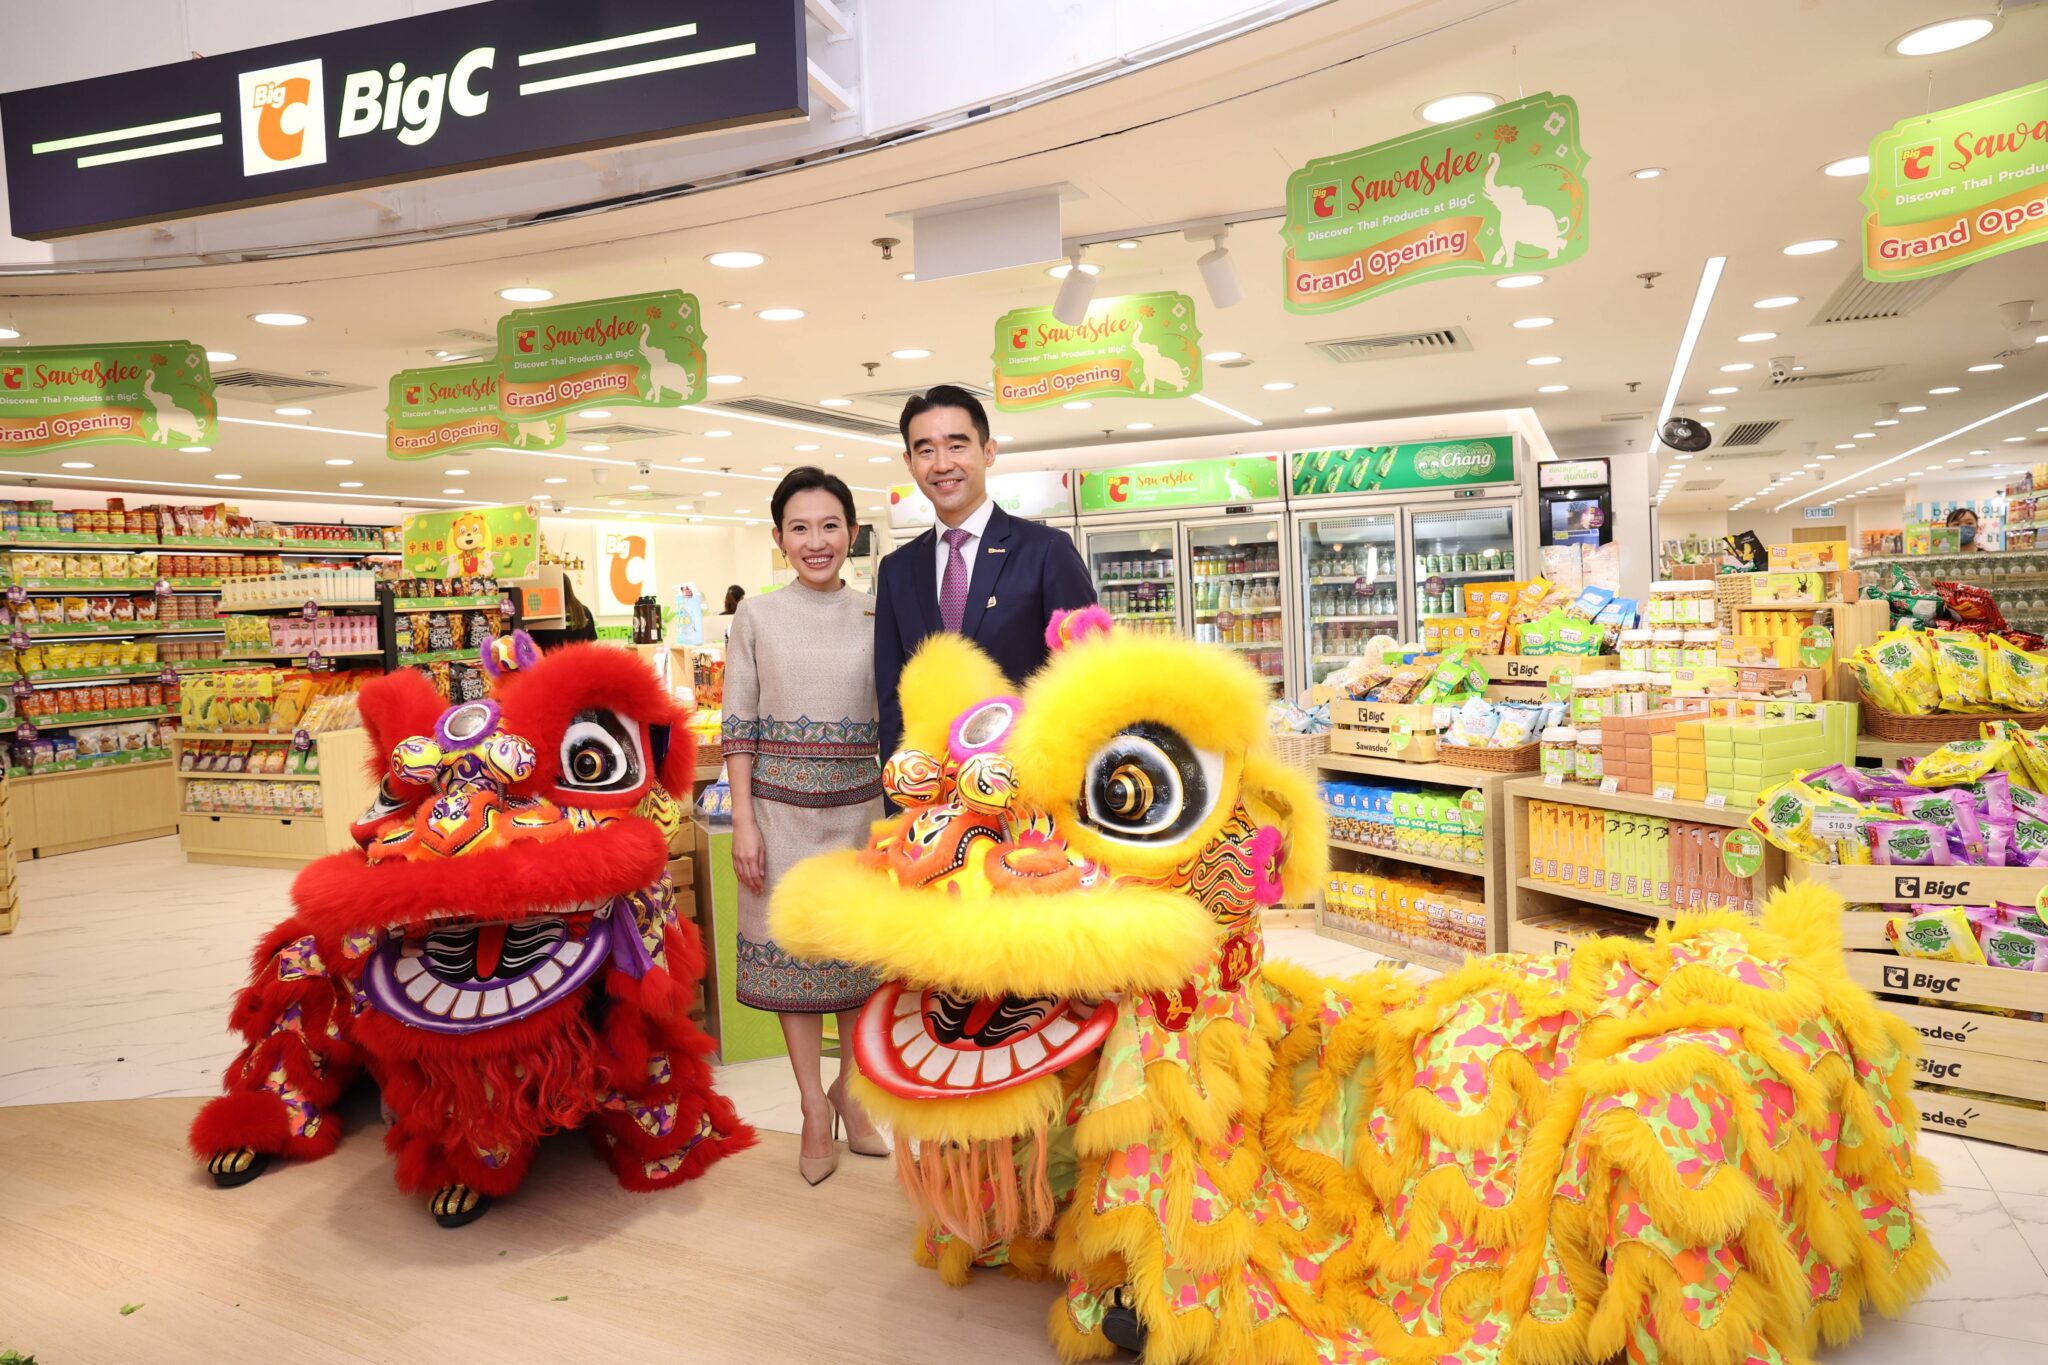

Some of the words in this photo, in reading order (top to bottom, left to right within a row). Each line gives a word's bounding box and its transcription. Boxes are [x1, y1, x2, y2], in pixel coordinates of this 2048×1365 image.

[252, 80, 286, 109] Big
[338, 46, 496, 146] BigC
[1948, 120, 2048, 172] Sawa
[1895, 186, 1956, 206] Discover
[1962, 175, 1993, 191] Thai
[1999, 162, 2048, 182] Produ
[1307, 225, 1354, 242] Discover
[1357, 218, 1380, 232] Thai
[1382, 206, 1430, 226] Products
[1434, 202, 1446, 214] at
[1448, 193, 1477, 211] BigC
[1879, 220, 1968, 259] Grand
[1296, 260, 1362, 294] Grand
[1369, 229, 1466, 274] Opening
[514, 358, 548, 369] Discover
[551, 356, 567, 365] Thai
[568, 353, 603, 364] Products
[605, 351, 613, 359] at
[615, 348, 634, 359] BigC
[1008, 354, 1040, 365] Discover
[1043, 352, 1058, 361] Thai
[1061, 348, 1095, 360] Products
[1107, 344, 1127, 355] BigC
[427, 375, 497, 404] Sawasd
[506, 385, 556, 407] Grand
[560, 372, 628, 396] Opening
[1002, 379, 1048, 399] Grand
[1053, 366, 1121, 389] Opening
[42, 395, 61, 404] Thai
[63, 394, 103, 403] Products
[117, 392, 138, 402] BigC
[402, 410, 431, 418] Discover
[448, 406, 478, 414] Products
[0, 423, 48, 441] rand
[53, 413, 131, 436] Opening
[394, 432, 436, 448] Grand
[440, 422, 499, 441] Opening
[1440, 452, 1492, 468] Chang
[431, 639, 453, 648] SKIN
[1519, 664, 1539, 677] BigC
[463, 689, 483, 700] SKIN
[1368, 711, 1385, 723] BigC
[1356, 741, 1388, 753] Sawasdee
[1828, 821, 1853, 830] $10.9
[1924, 881, 1970, 899] BigC
[1912, 973, 1960, 993] BigC
[1914, 1025, 1966, 1043] sdee
[1915, 1058, 1962, 1079] BigC
[1921, 1110, 1968, 1128] sdee
